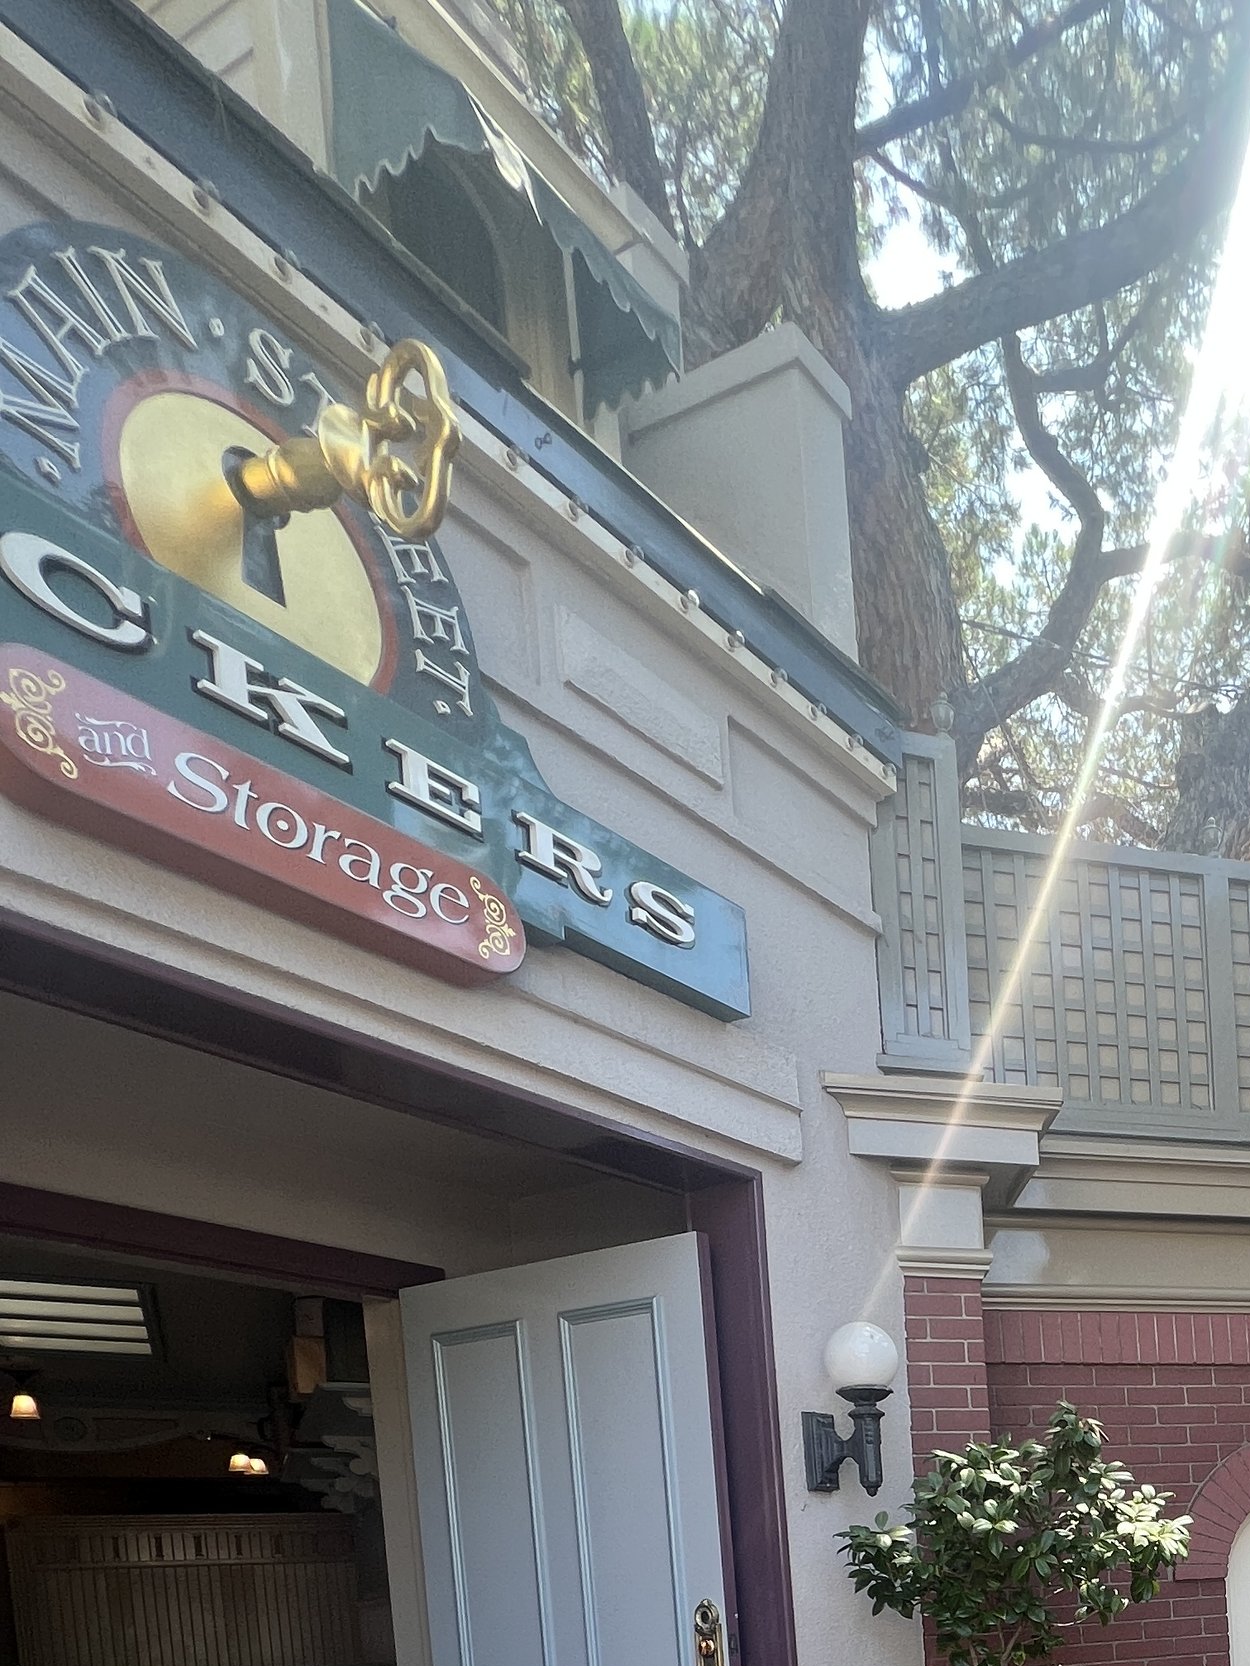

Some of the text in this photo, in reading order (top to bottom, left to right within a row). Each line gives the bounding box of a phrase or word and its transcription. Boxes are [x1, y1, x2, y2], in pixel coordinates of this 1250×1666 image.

[0, 246, 474, 718] MAIN STEET
[77, 716, 471, 925] and Storage
